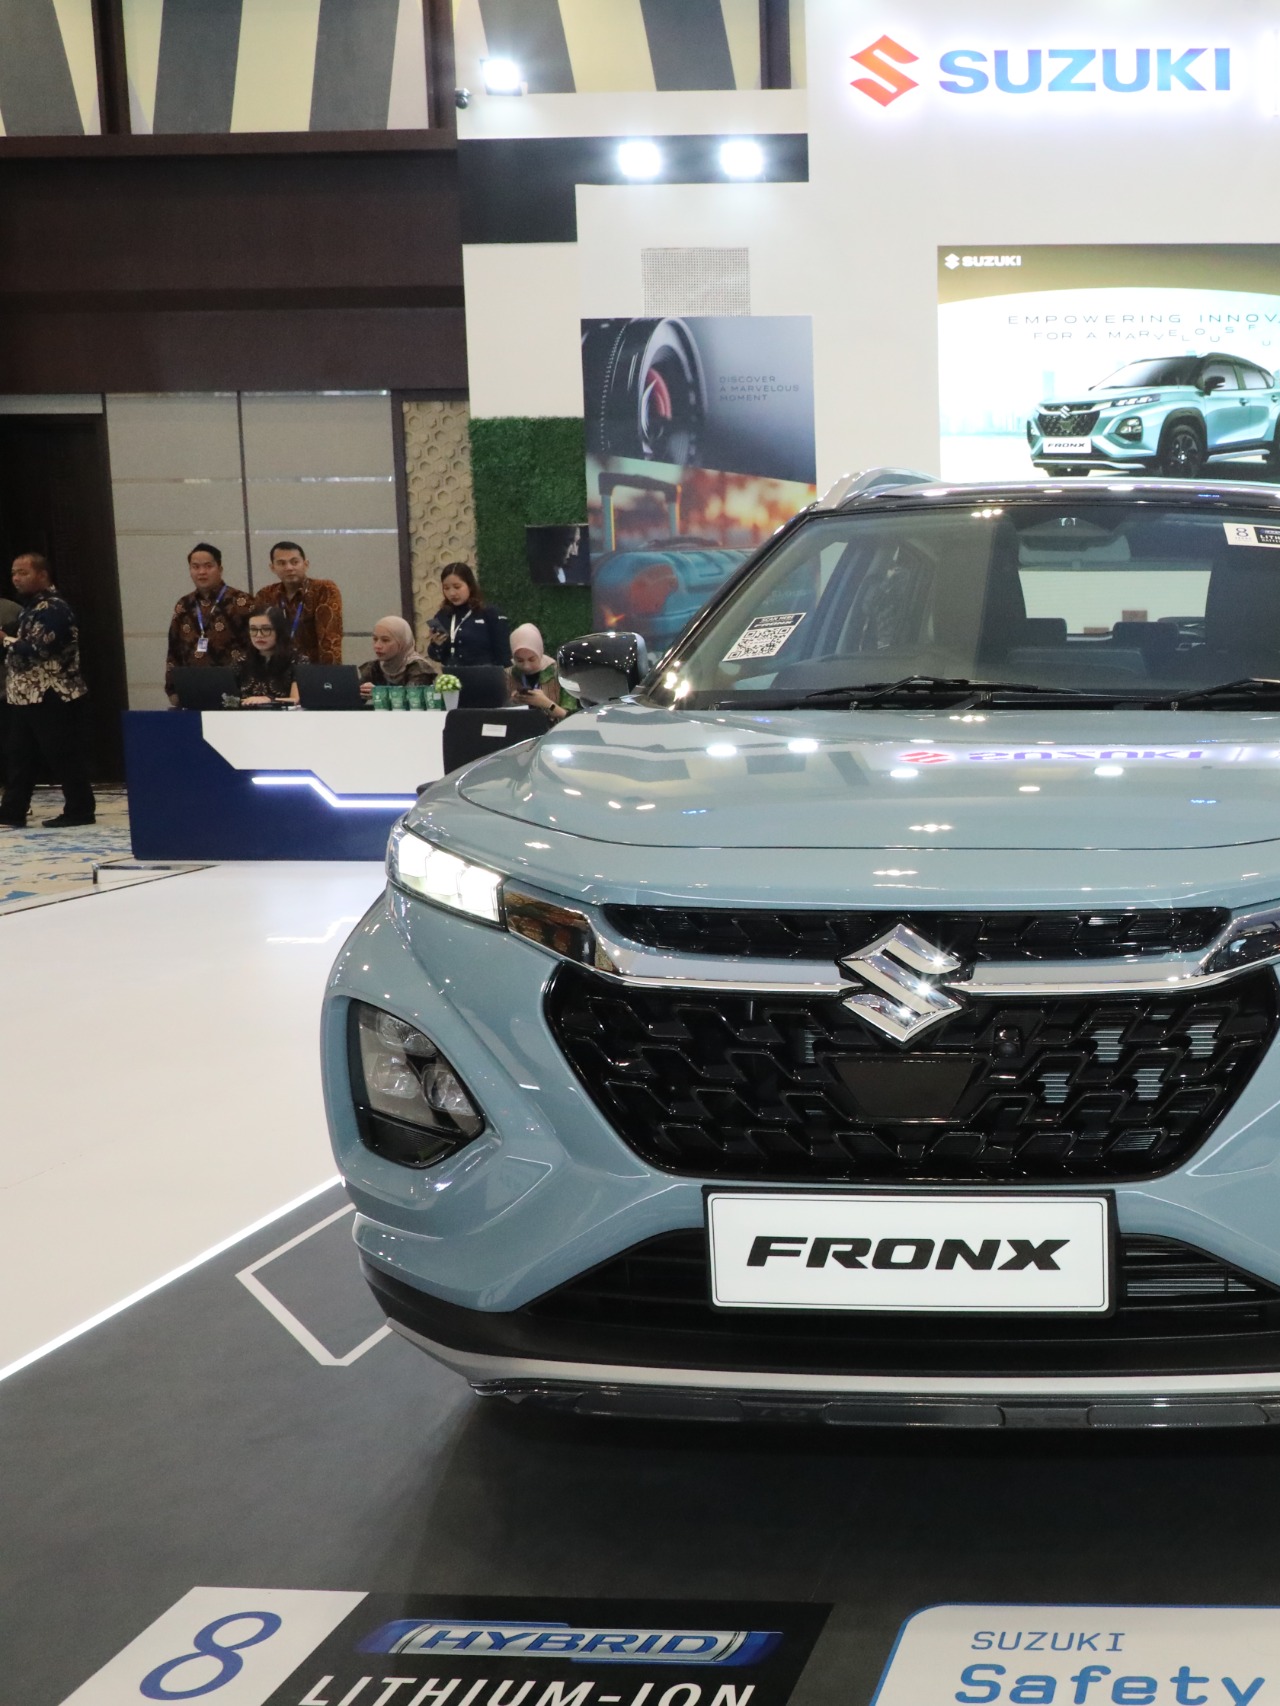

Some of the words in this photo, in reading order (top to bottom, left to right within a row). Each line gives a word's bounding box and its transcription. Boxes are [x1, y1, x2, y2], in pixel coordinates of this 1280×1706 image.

[938, 47, 1231, 94] SUZUKI
[961, 255, 1022, 268] SUZUKI
[1007, 314, 1182, 324] EMPOWERING
[1033, 332, 1073, 340] FOR
[1108, 326, 1236, 343] MARVELOUS
[719, 375, 776, 384] DISCOVER
[731, 384, 800, 393] MARVELOUS
[719, 393, 768, 401] MOMENT
[1236, 528, 1249, 537] 8
[746, 1235, 1071, 1271] FRONX
[419, 1629, 719, 1655] HYBRID
[971, 1631, 1126, 1652] SUZUKI
[139, 1610, 282, 1701] 8
[297, 1675, 756, 1706] LITHIUM-ION
[955, 1663, 1266, 1706] Safety
